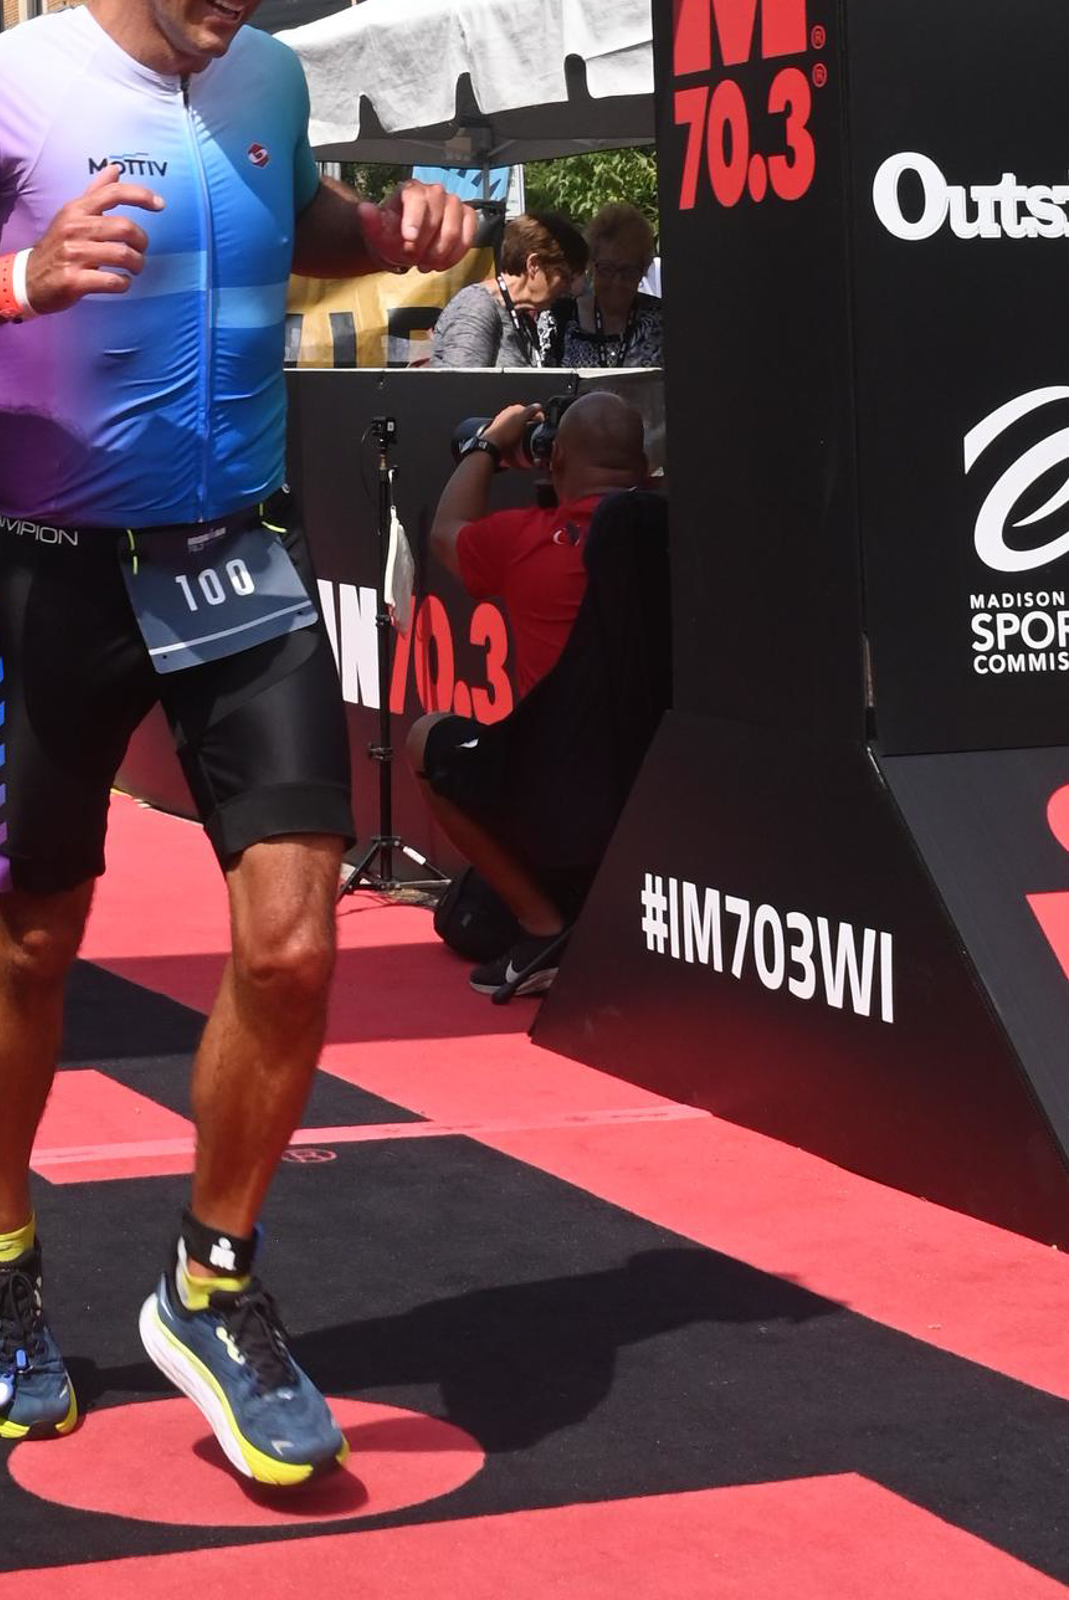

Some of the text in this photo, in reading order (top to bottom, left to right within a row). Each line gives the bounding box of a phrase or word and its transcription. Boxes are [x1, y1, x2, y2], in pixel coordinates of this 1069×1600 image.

[674, 68, 816, 210] 70.3
[175, 558, 255, 612] 100
[970, 591, 1065, 609] MADISON
[641, 873, 894, 1024] #IM703WI
